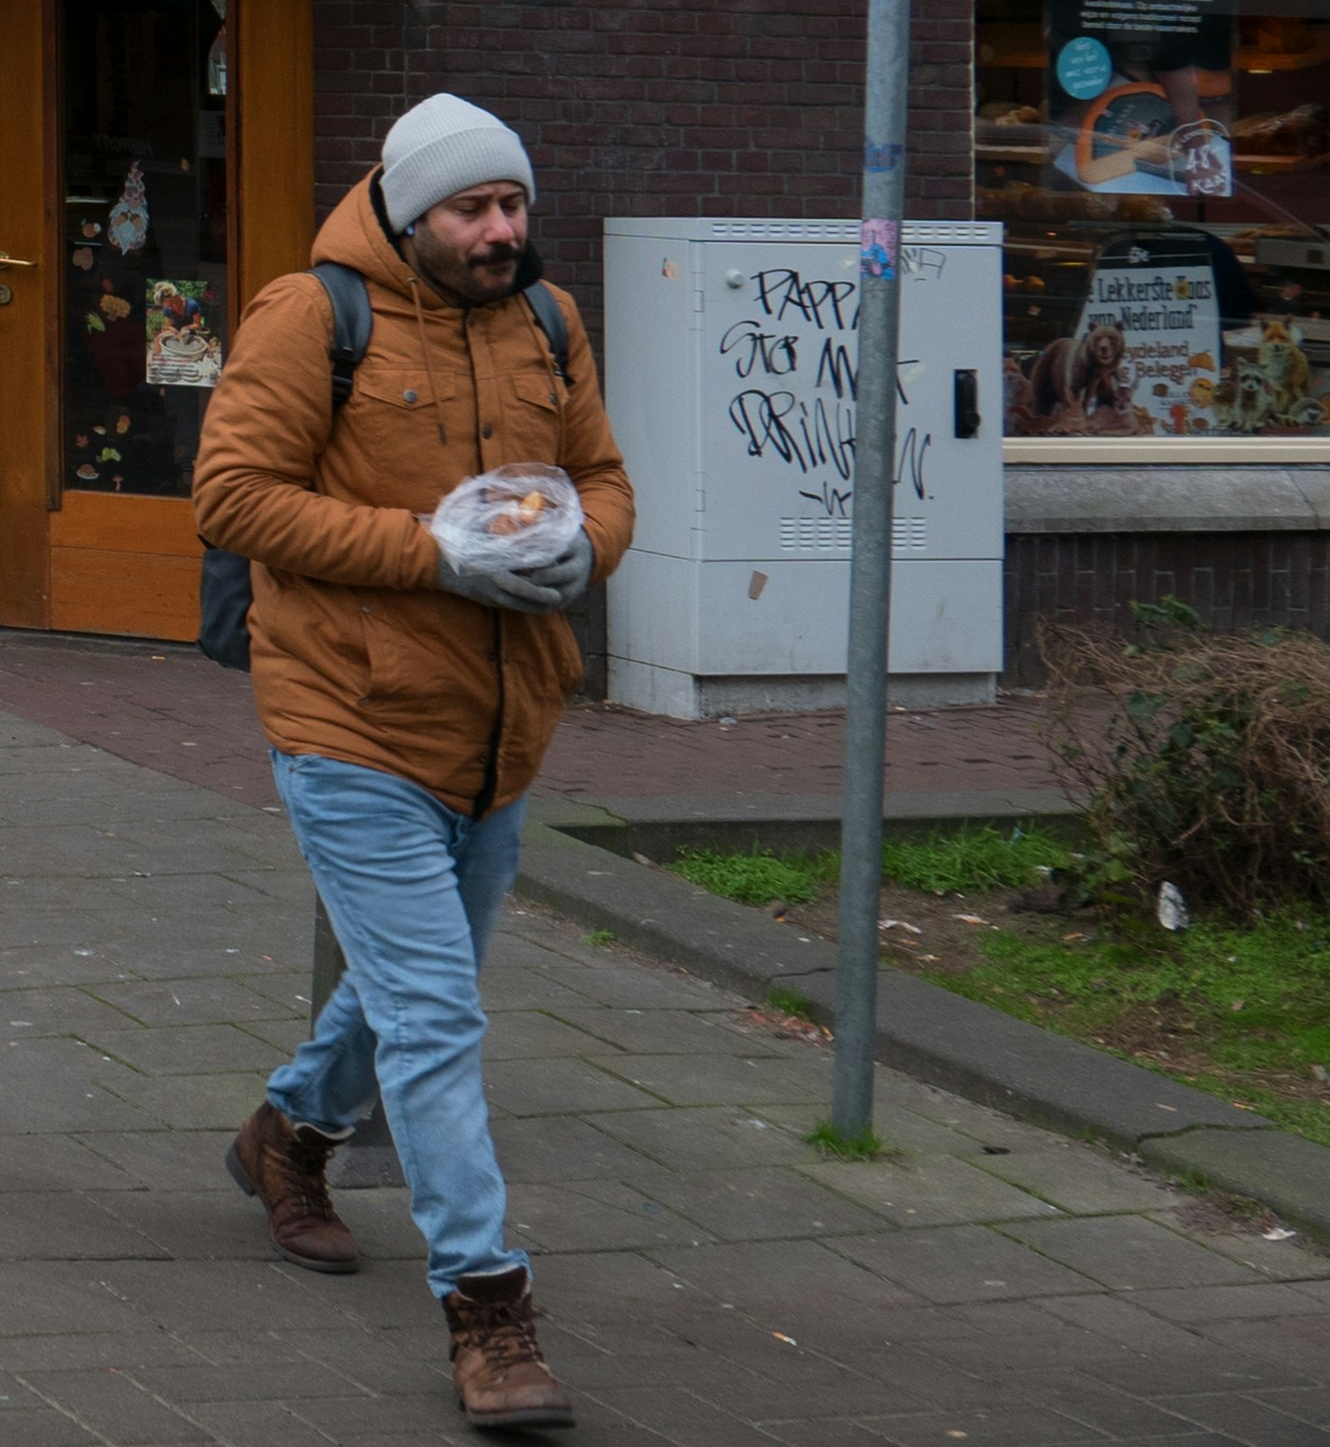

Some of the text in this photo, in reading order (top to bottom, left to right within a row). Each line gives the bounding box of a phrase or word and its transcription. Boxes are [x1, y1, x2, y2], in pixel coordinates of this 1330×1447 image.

[750, 269, 860, 331] PAPP
[1097, 275, 1173, 303] Lekkerste
[814, 337, 920, 406] MT
